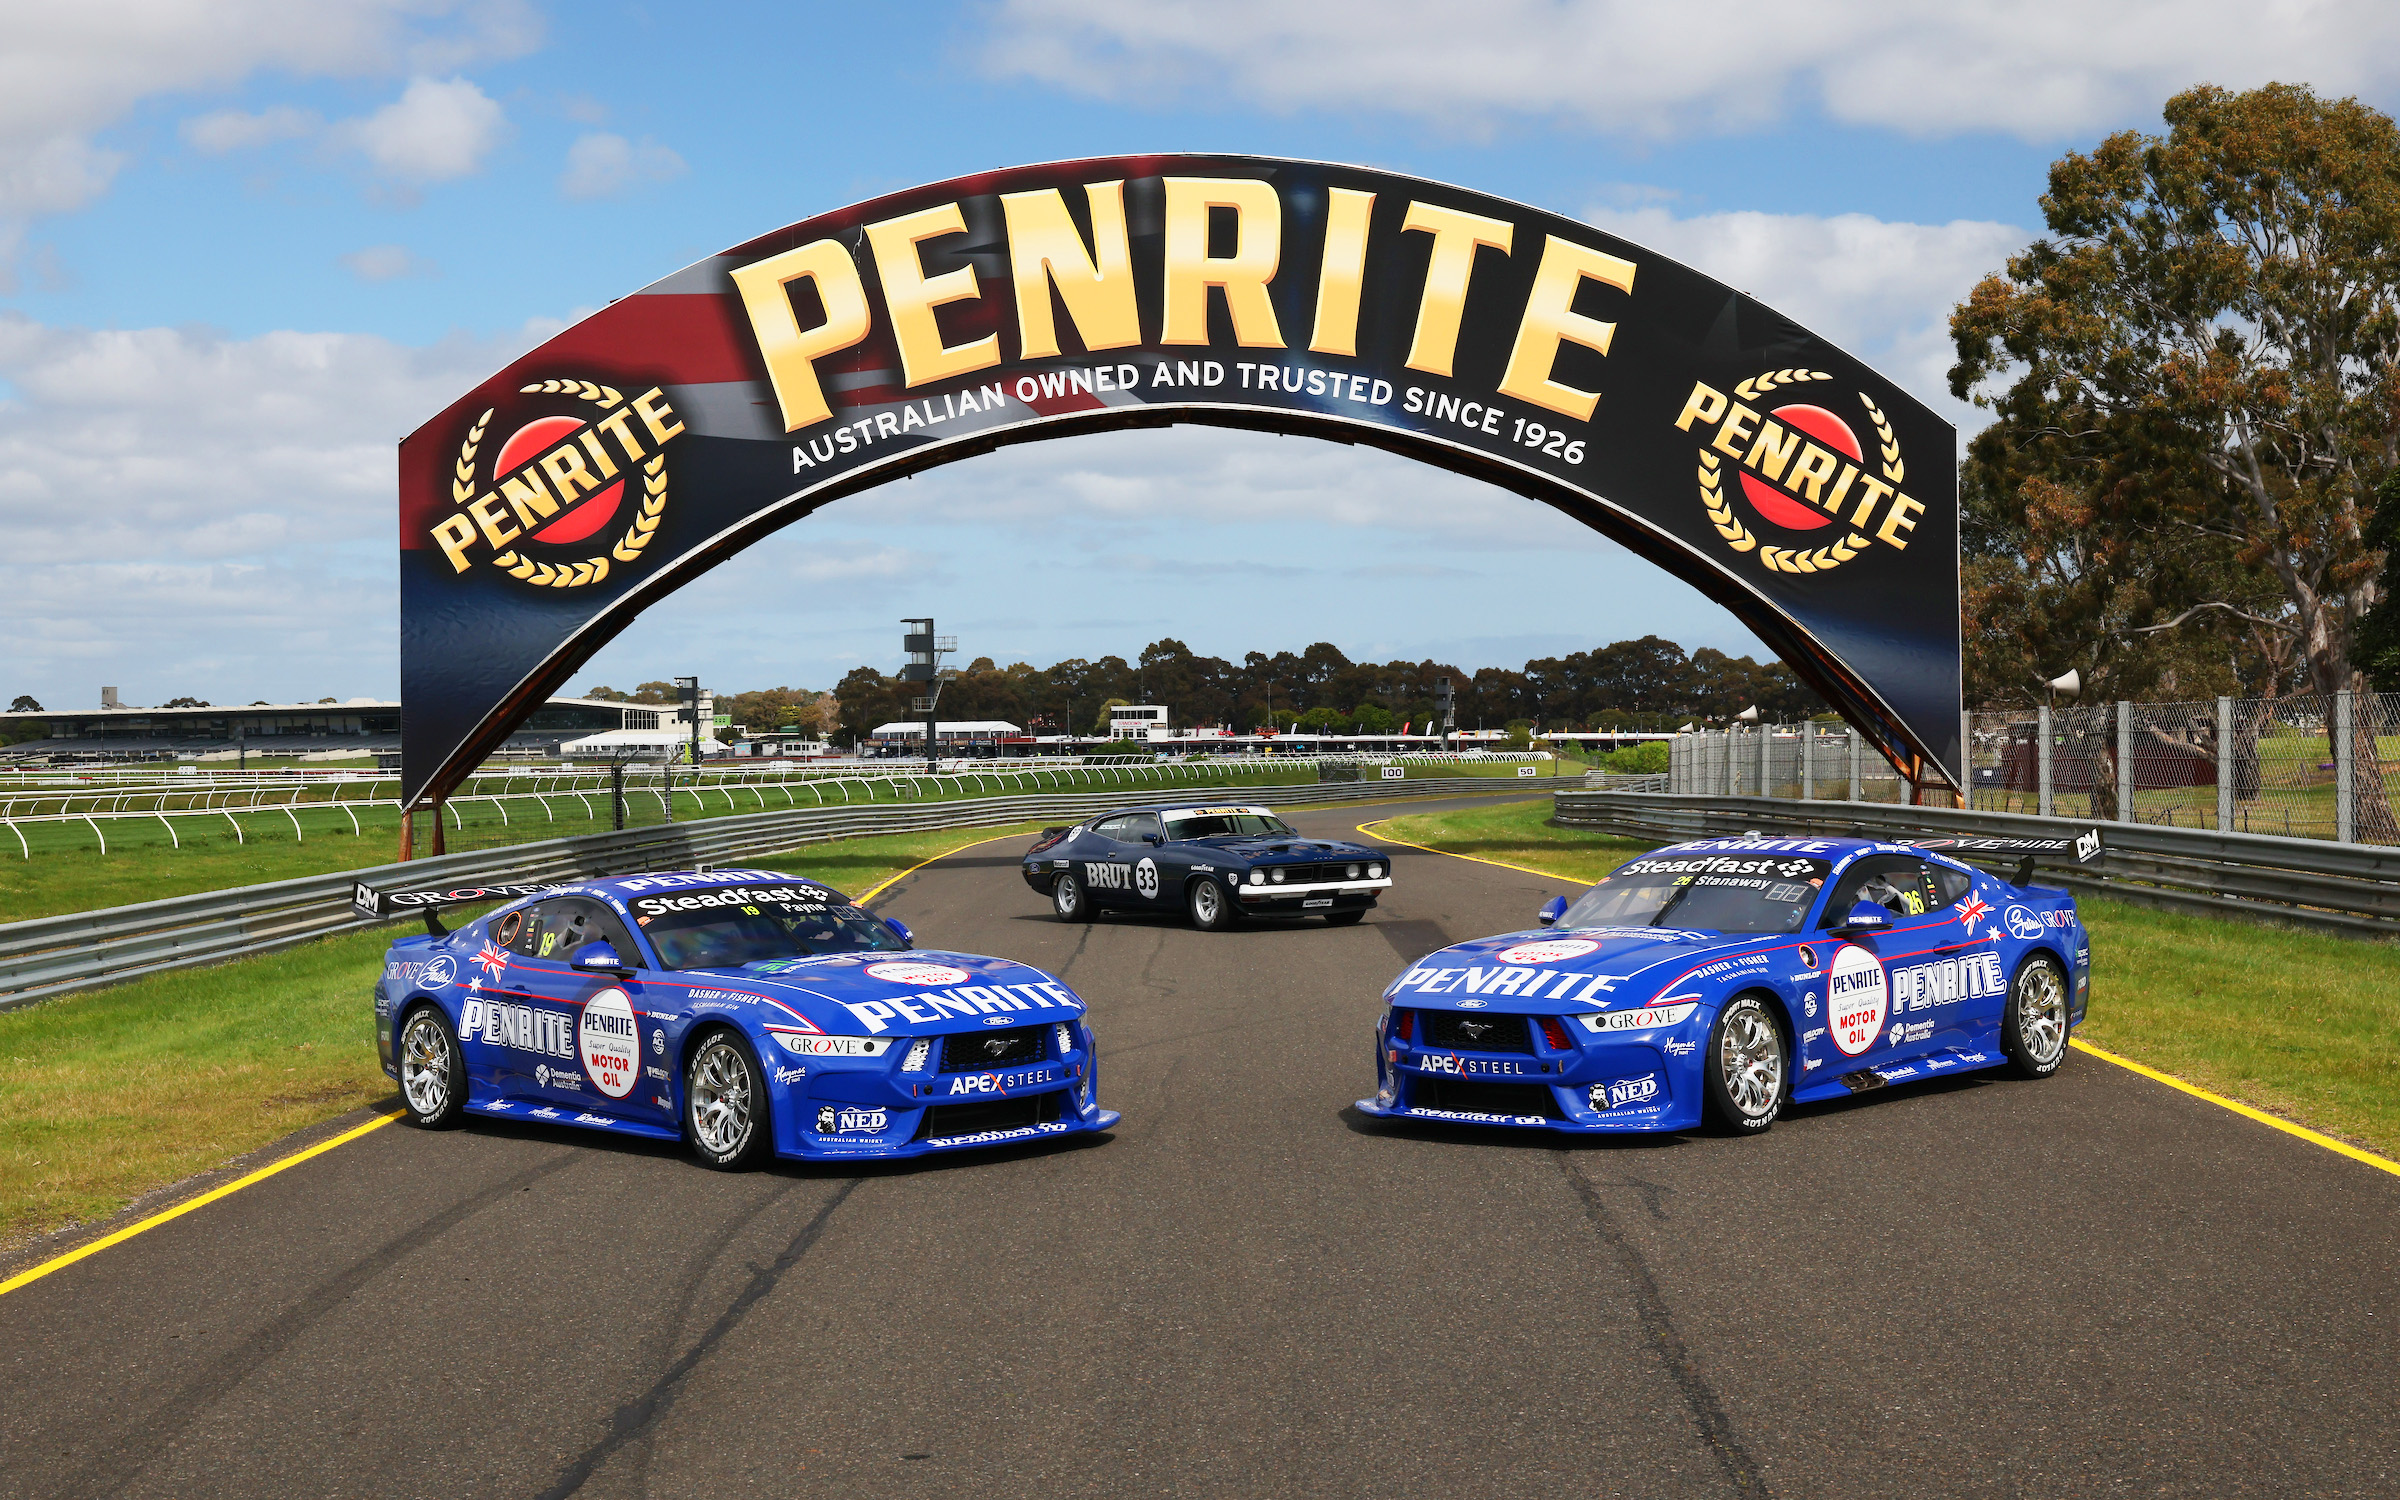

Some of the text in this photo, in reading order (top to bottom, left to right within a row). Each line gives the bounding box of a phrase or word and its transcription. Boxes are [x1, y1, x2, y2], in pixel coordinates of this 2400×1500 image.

[729, 176, 1638, 433] PENRITE
[792, 361, 1587, 475] AUSTRALIAN OWNED AND TRUSTED SINCE 1926
[1674, 380, 1926, 551] PENRITE
[430, 386, 687, 575] PENRITE
[1383, 768, 1402, 777] 100
[1651, 840, 1839, 853] PENRITE
[1892, 838, 2071, 850] ROVE HIRE
[1085, 862, 1131, 889] BRUT
[1190, 863, 1215, 873] GOODYEAR
[1622, 856, 1776, 876] Steadfast
[615, 870, 803, 892] PENRITE
[1138, 867, 1157, 890] 33
[1672, 875, 1773, 891] 26 Stanaway
[390, 885, 539, 905] GROVE
[637, 886, 802, 917] Steadfast
[1904, 890, 1925, 915] 26
[740, 902, 827, 917] 19 Payne
[2041, 910, 2076, 928] GROVE
[2008, 908, 2043, 934] Gates
[540, 932, 556, 957] 19
[386, 961, 420, 980] GROVE
[421, 958, 454, 985] Gates
[584, 958, 620, 966] PENRITE
[1695, 961, 1732, 979] DASHER
[1738, 954, 1770, 967] FISHER
[2032, 960, 2048, 969] MAXX
[1716, 968, 1757, 984] TASMANIAN
[1794, 970, 1821, 982] DUNLOP
[1832, 969, 1881, 995] PENRITE
[1892, 951, 2007, 1015] PENRITE
[688, 988, 720, 1000] DASHER
[727, 993, 761, 1006] FISHER
[1395, 967, 1631, 1008] PENRITE
[651, 1011, 679, 1022] DUNLOP
[843, 981, 1081, 1035] PENRITE
[1722, 1001, 1740, 1027] SPORT
[1740, 999, 1761, 1009] MAXX
[458, 996, 575, 1060] PENRITE
[584, 1012, 633, 1036] PENRITE
[1610, 1009, 1676, 1029] GROVE
[1839, 1009, 1876, 1030] MOTOR
[1905, 1018, 1935, 1033] Dementia
[1663, 1036, 1696, 1056] Haymes
[1849, 1028, 1866, 1044] OIL
[1904, 1029, 1932, 1043] Australia
[588, 1040, 631, 1056] Super Quality
[692, 1033, 724, 1071] DUNLOP
[790, 1037, 857, 1056] GROVE
[591, 1053, 630, 1072] MOTOR
[1420, 1053, 1523, 1076] APEX STEEL
[2036, 1048, 2064, 1073] DUNLOP
[550, 1067, 582, 1082] Dementia
[603, 1072, 621, 1088] OIL
[774, 1065, 806, 1086] Haymes
[949, 1070, 1052, 1095] APEX STEEL
[552, 1079, 581, 1091] Australia
[1612, 1080, 1657, 1103] NED
[420, 1099, 448, 1123] DUNLOP
[840, 1112, 887, 1129] NED
[1405, 1107, 1512, 1123] Steadfast
[1597, 1110, 1635, 1119] AUSTRALIAN
[1743, 1104, 1778, 1128] DUNLOP
[927, 1124, 1040, 1148] Steadfast
[718, 1149, 738, 1163] MAXX
